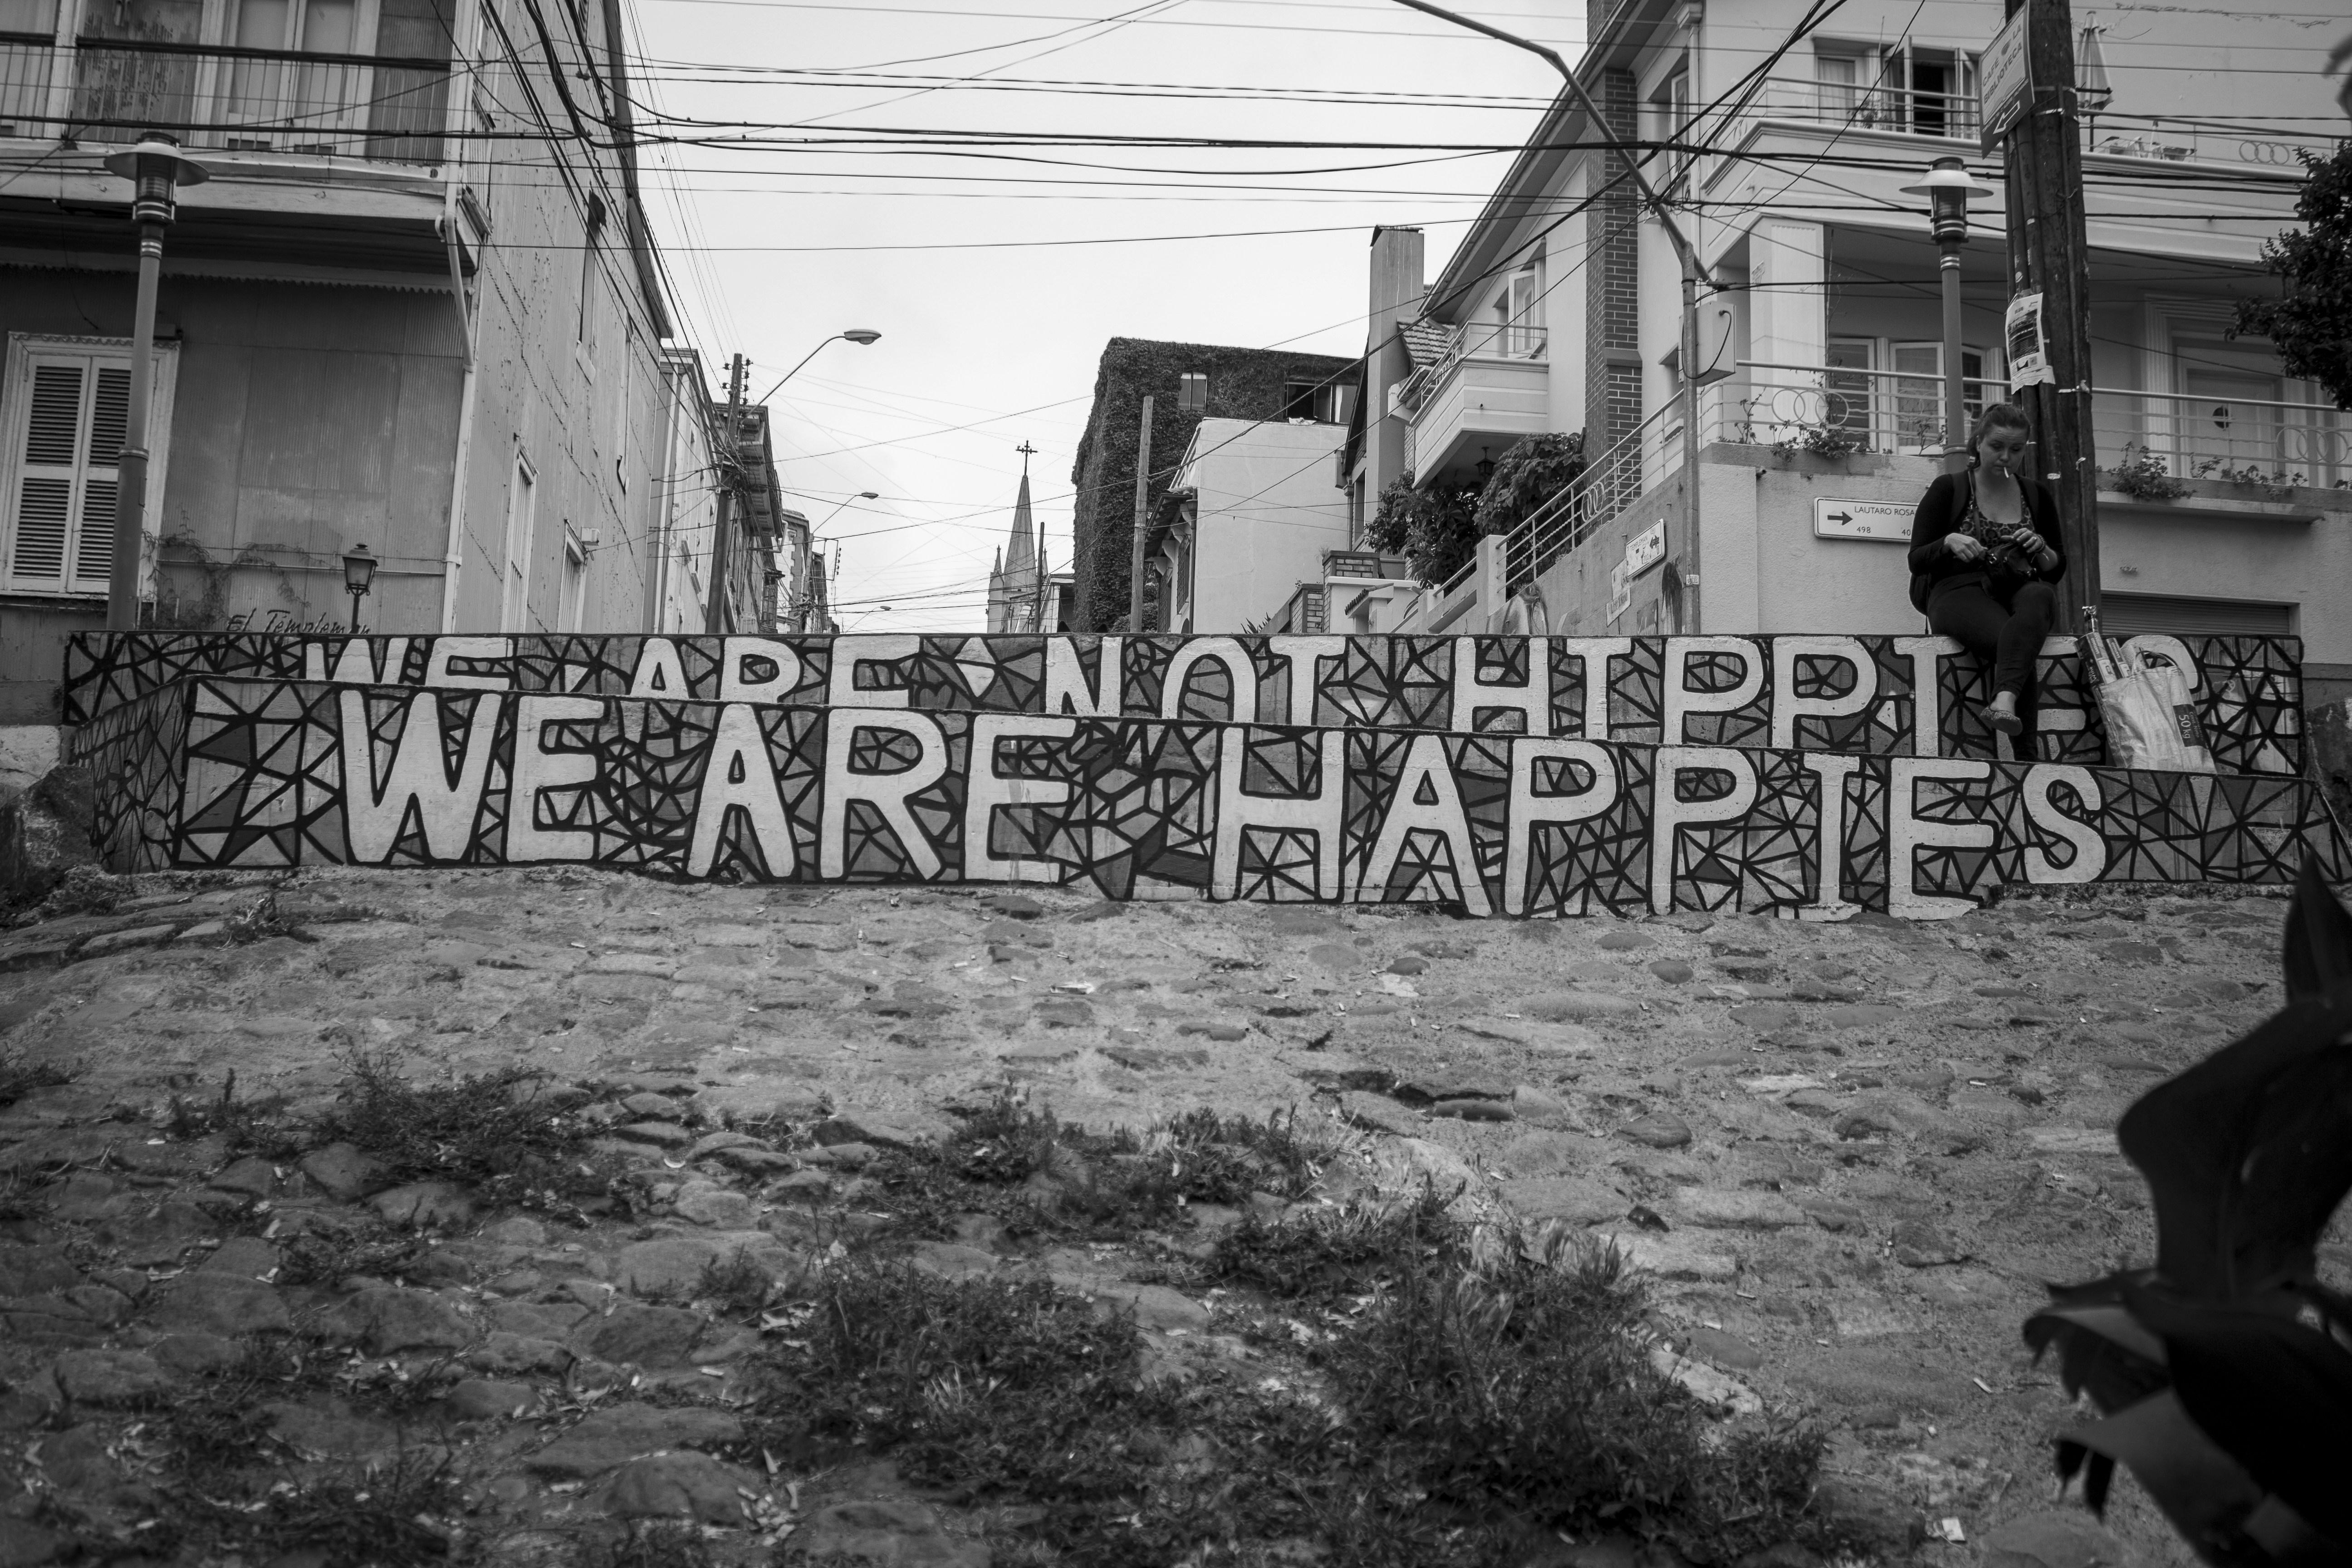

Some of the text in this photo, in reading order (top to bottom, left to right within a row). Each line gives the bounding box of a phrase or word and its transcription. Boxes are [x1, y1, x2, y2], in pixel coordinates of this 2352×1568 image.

[2013, 24, 2022, 40] LA
[1984, 42, 2023, 105] BIBLIOTECA
[1855, 506, 1915, 516] LAUTARO ROSA
[1630, 535, 1648, 552] TEMPLEMAN
[227, 608, 257, 632] El
[631, 636, 921, 707] ARE
[1045, 636, 1347, 726] NOT
[2179, 714, 2191, 739] 50 kg
[339, 689, 2106, 921] WE ARE HAPPIES
